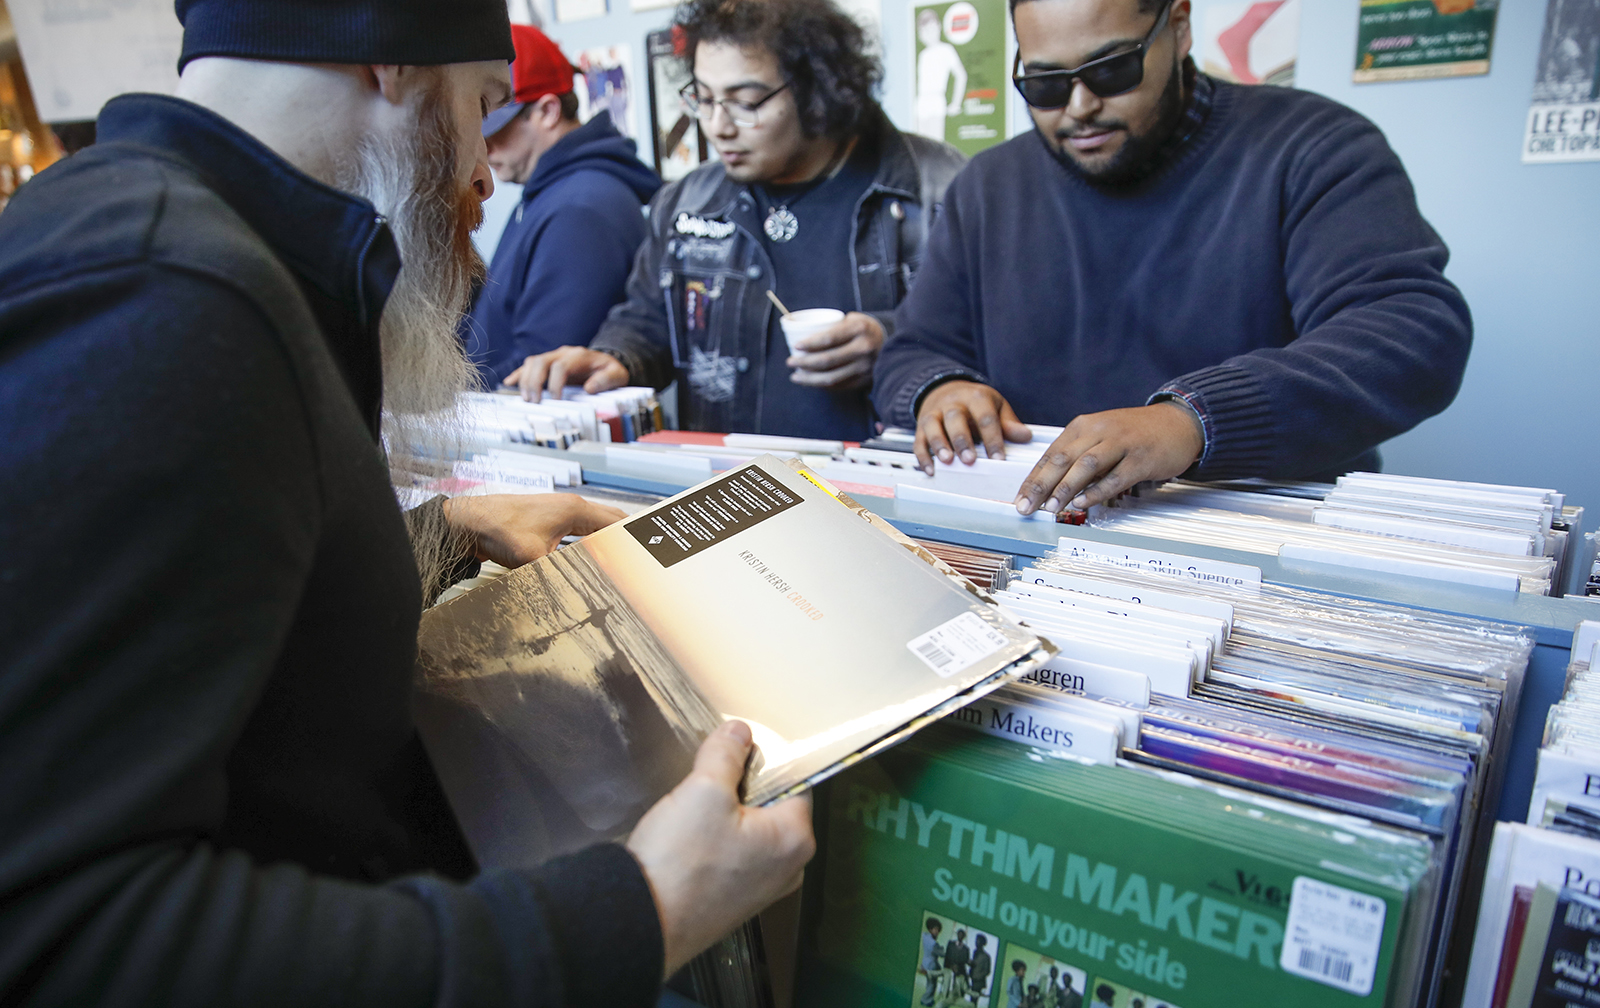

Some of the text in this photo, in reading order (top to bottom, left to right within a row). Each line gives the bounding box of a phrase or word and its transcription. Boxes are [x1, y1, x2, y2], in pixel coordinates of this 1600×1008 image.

[498, 469, 549, 489] Yamaguchi
[738, 549, 824, 621] KRISTIN HERSH CROOKED
[990, 707, 1074, 748] Makers
[848, 785, 1284, 970] RHYTHM MAKER
[931, 867, 1188, 990] Soul on your side
